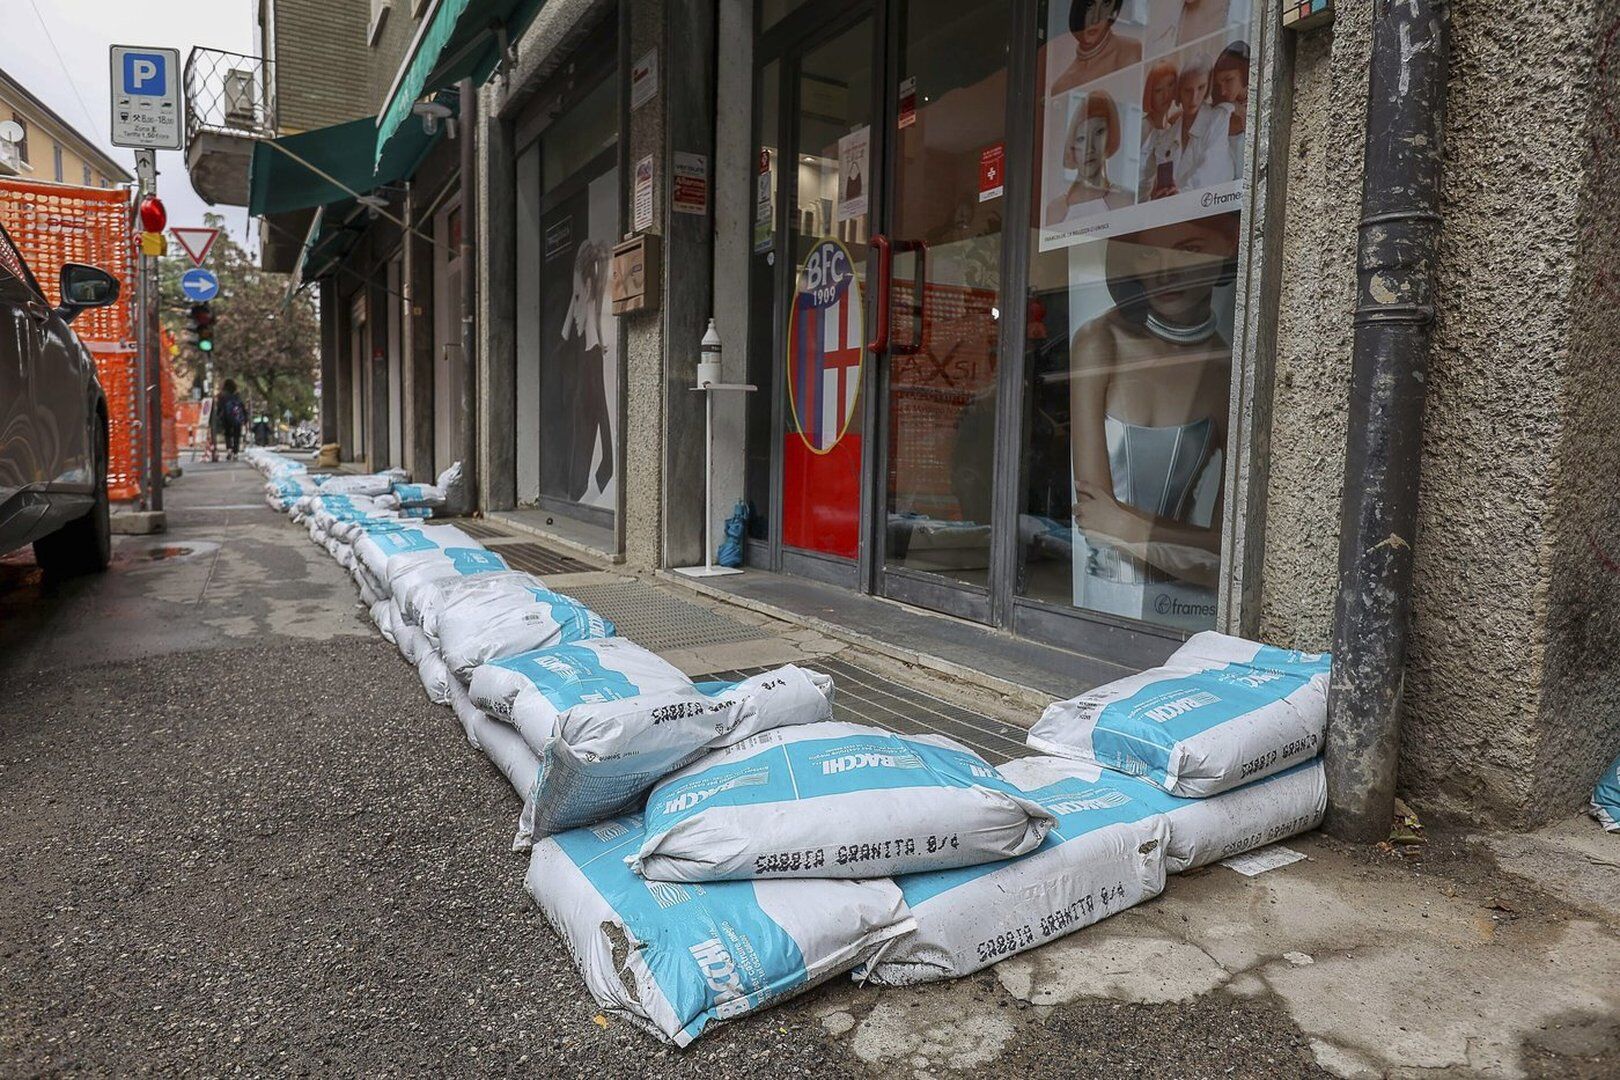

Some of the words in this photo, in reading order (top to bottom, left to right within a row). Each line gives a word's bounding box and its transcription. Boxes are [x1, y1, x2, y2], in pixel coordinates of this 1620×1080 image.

[133, 60, 157, 88] P
[807, 243, 845, 290] BFC
[813, 285, 836, 306] 1909
[652, 702, 703, 725] SABBIA
[1145, 697, 1198, 723] BACCHI
[822, 753, 895, 775] BACCHI
[754, 848, 825, 875] SABBIA
[721, 920, 740, 943] meglio
[976, 925, 1035, 962] SABBIA
[1040, 894, 1095, 937] GRANITA
[735, 942, 755, 976] costruire
[688, 937, 751, 1014] BACCHI
